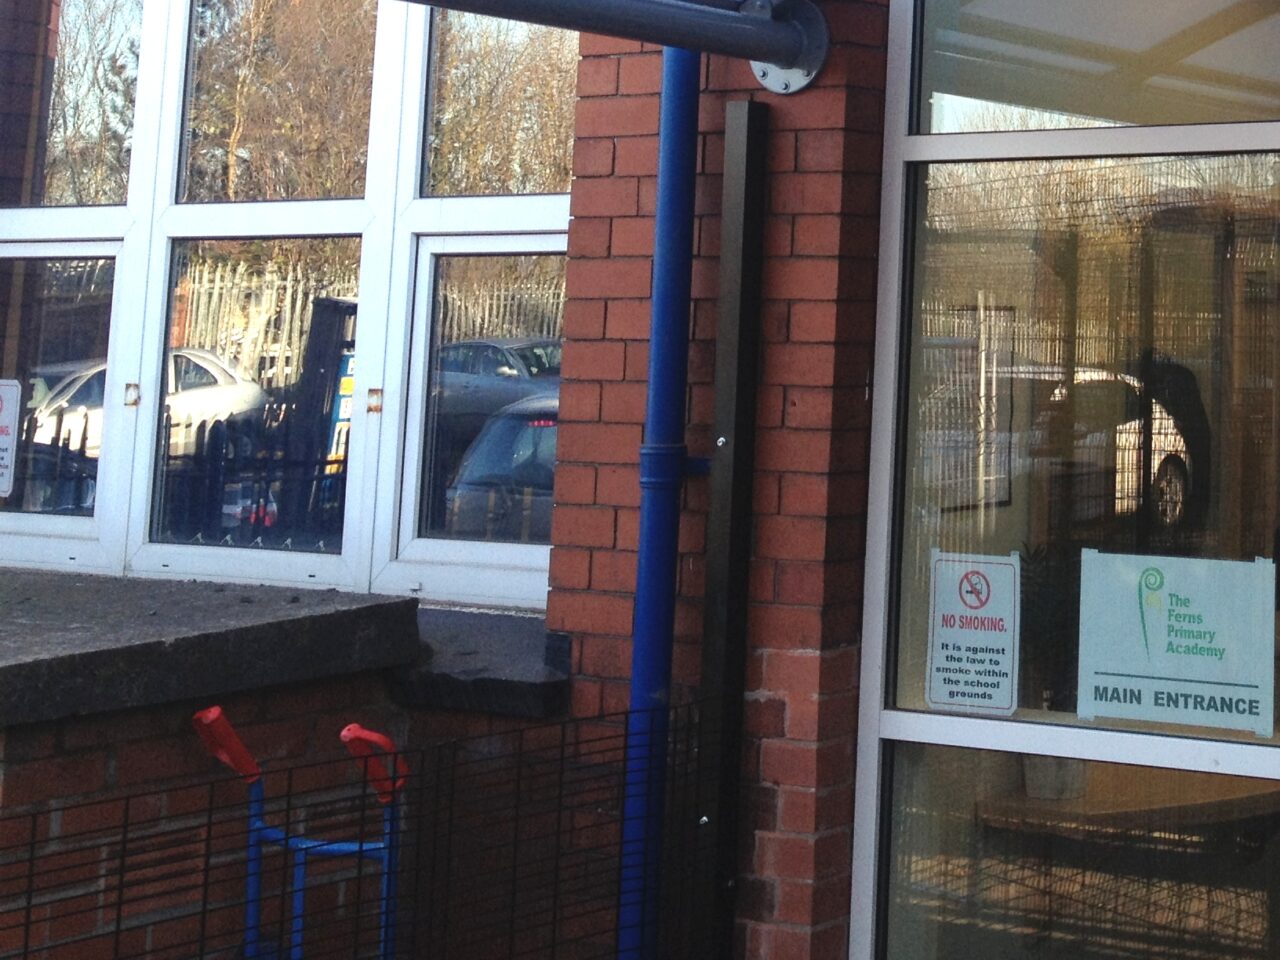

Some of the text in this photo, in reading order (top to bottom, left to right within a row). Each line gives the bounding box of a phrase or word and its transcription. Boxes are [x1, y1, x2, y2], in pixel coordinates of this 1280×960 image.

[1168, 593, 1190, 607] The
[941, 613, 1007, 632] NO SMOKING.
[1167, 609, 1203, 624] Ferns
[1167, 624, 1216, 643] Primary
[941, 642, 1006, 655] It is against
[1166, 641, 1226, 660] Academy
[945, 654, 1000, 666] the law to
[935, 666, 1009, 678] smoke within
[943, 677, 1000, 689] the school
[949, 690, 993, 700] grounds
[1094, 685, 1260, 716] MAIN ENTRANCE
